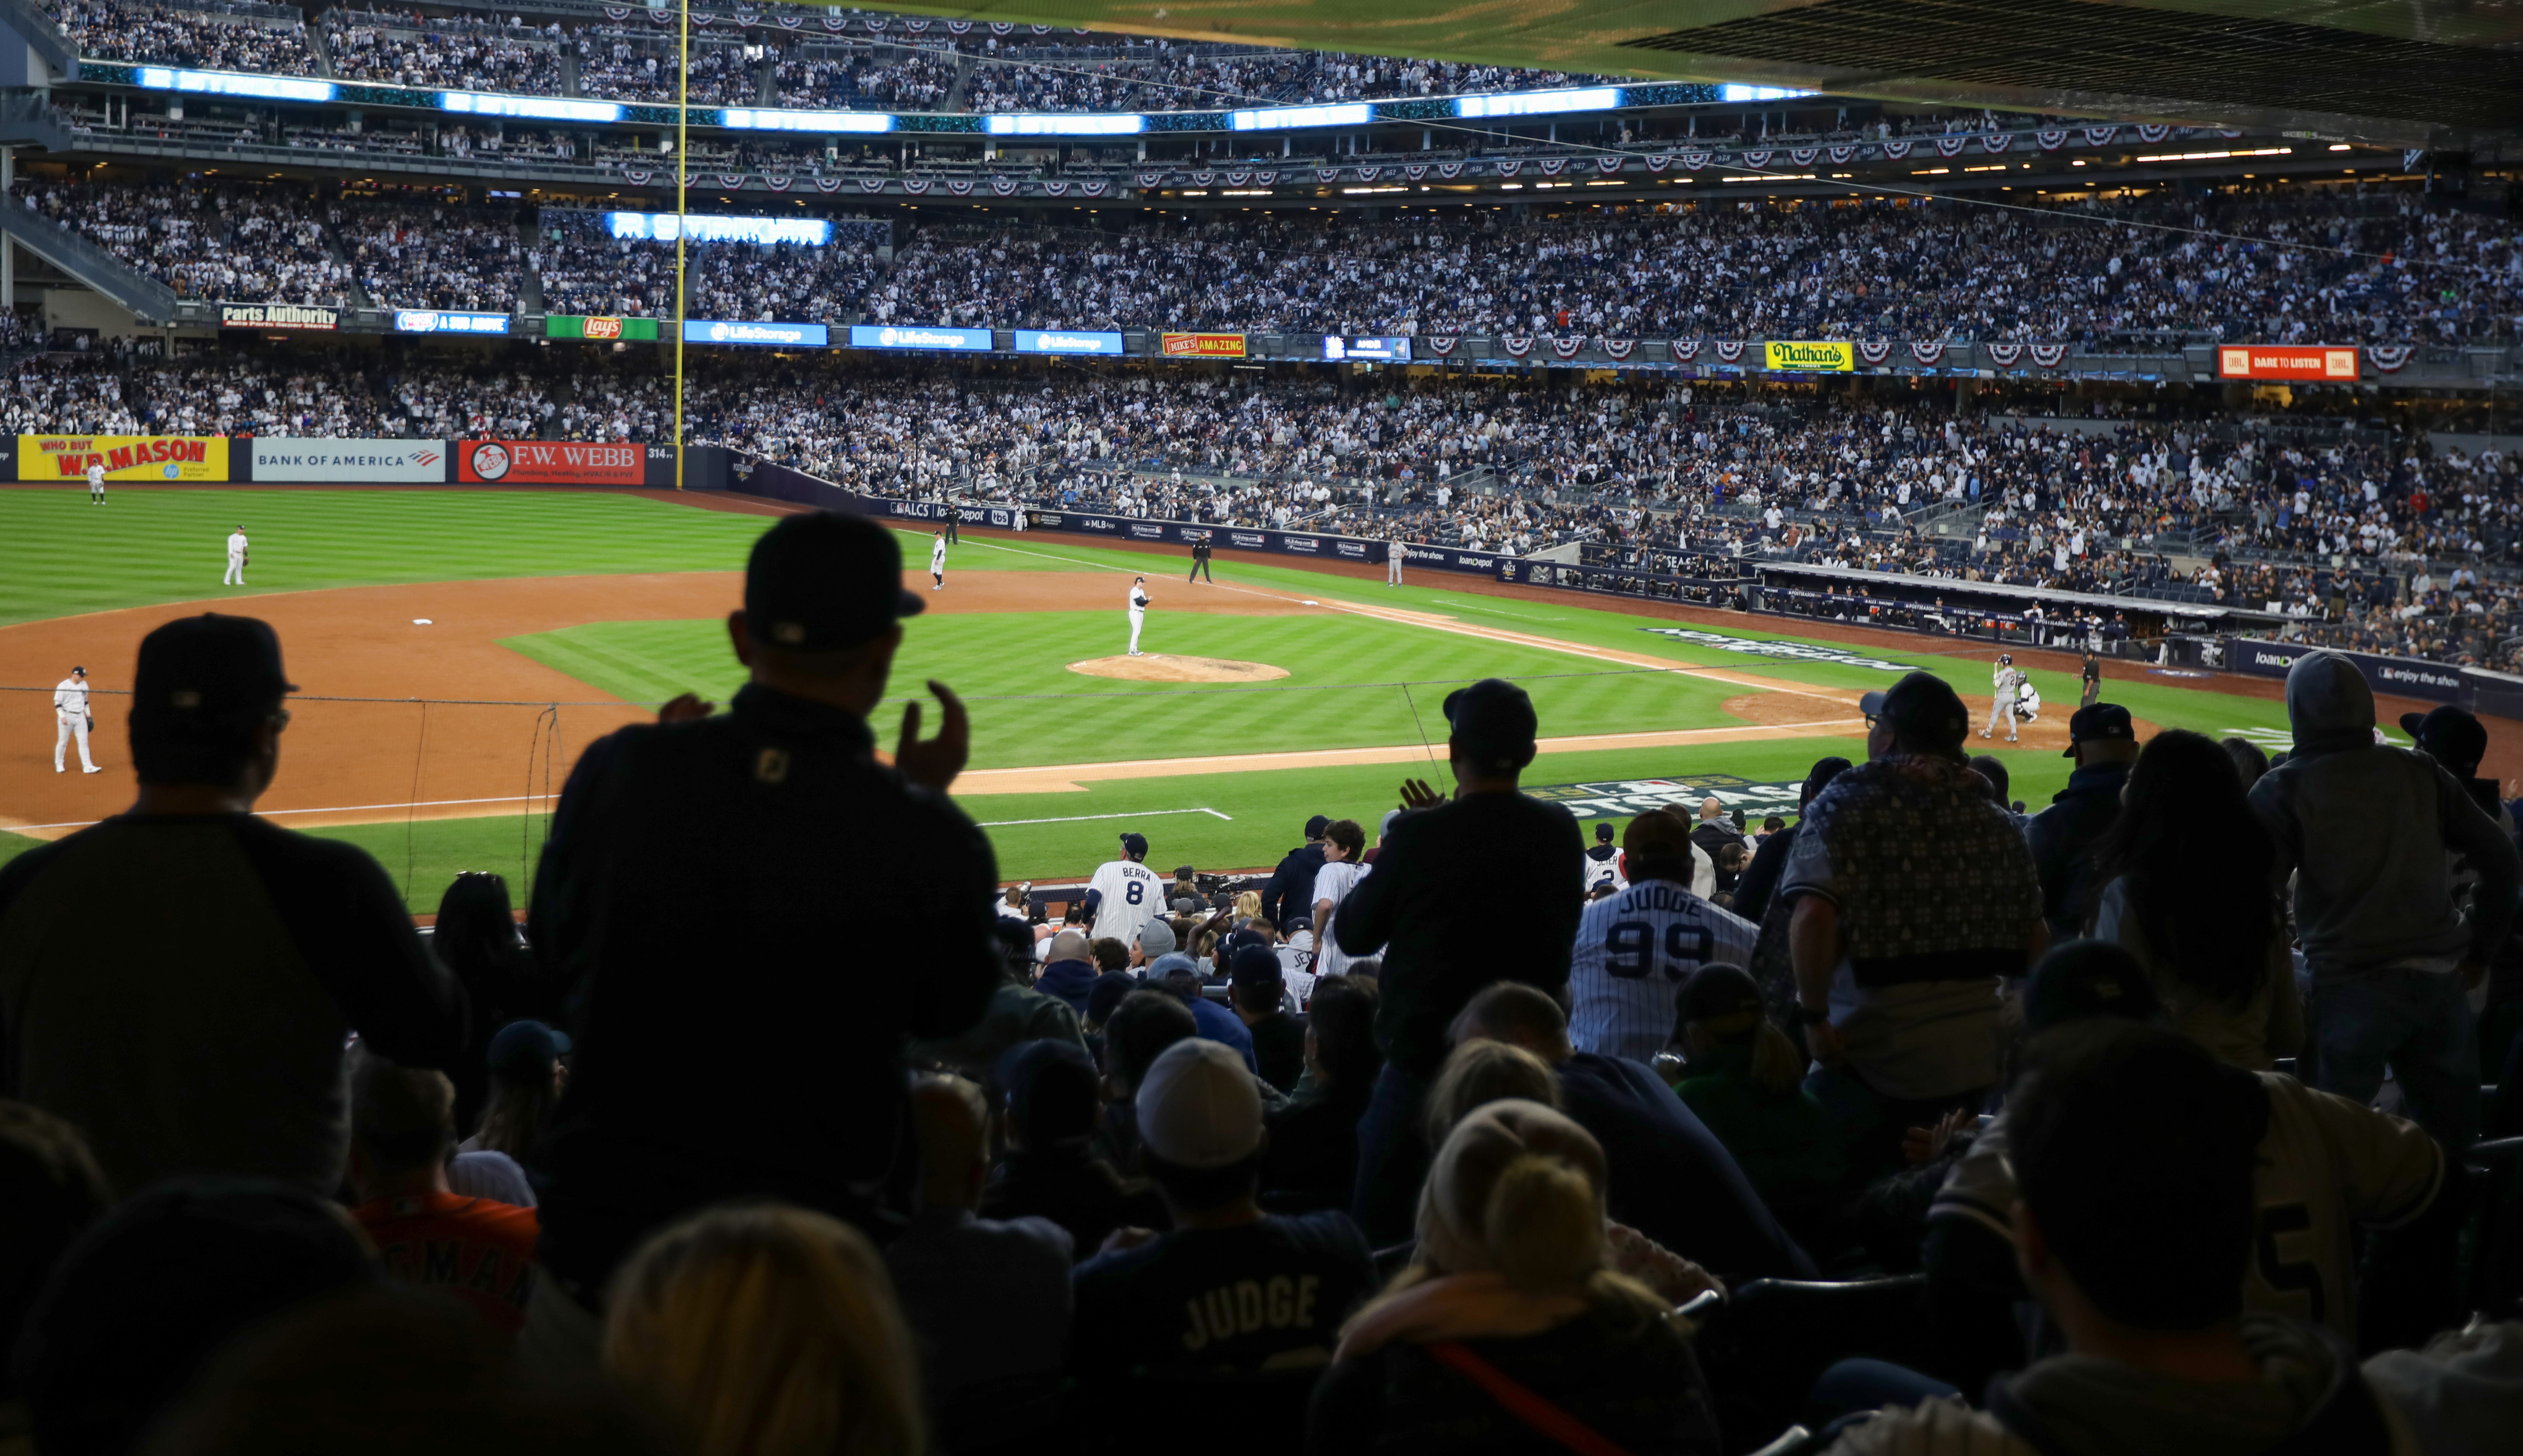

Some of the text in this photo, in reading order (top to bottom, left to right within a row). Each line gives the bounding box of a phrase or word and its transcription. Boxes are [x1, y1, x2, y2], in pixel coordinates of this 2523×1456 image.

[615, 213, 824, 245] 2 STRIKES
[223, 306, 337, 324] Parts Authority
[439, 316, 448, 329] A
[587, 318, 620, 338] Lay's
[1170, 339, 1242, 352] MIKE'S AMAZING
[1773, 343, 1842, 362] Nathan's
[2254, 357, 2321, 369] DARE TO LISTEN
[40, 440, 93, 451] WHO BUT
[259, 456, 405, 466] BANK OF AMERICA
[513, 446, 635, 467] F.W. WEBB
[648, 448, 666, 459] 314
[512, 469, 550, 478] Plumbing,
[552, 470, 582, 479] Heating,
[904, 502, 929, 517] ALCS
[993, 512, 1007, 523] tbs
[1091, 520, 1106, 528] MLB
[1419, 550, 1428, 558] the
[1428, 552, 1444, 561] show.
[1459, 556, 1493, 568] loanDepot
[2394, 668, 2419, 683] enjoy
[2420, 671, 2436, 684] the
[1123, 867, 1150, 882] BERRA
[1126, 880, 1144, 905] 8
[1620, 886, 1701, 917] JUDGE
[1605, 920, 1715, 983] 99
[1180, 1273, 1322, 1352] JUDGE
